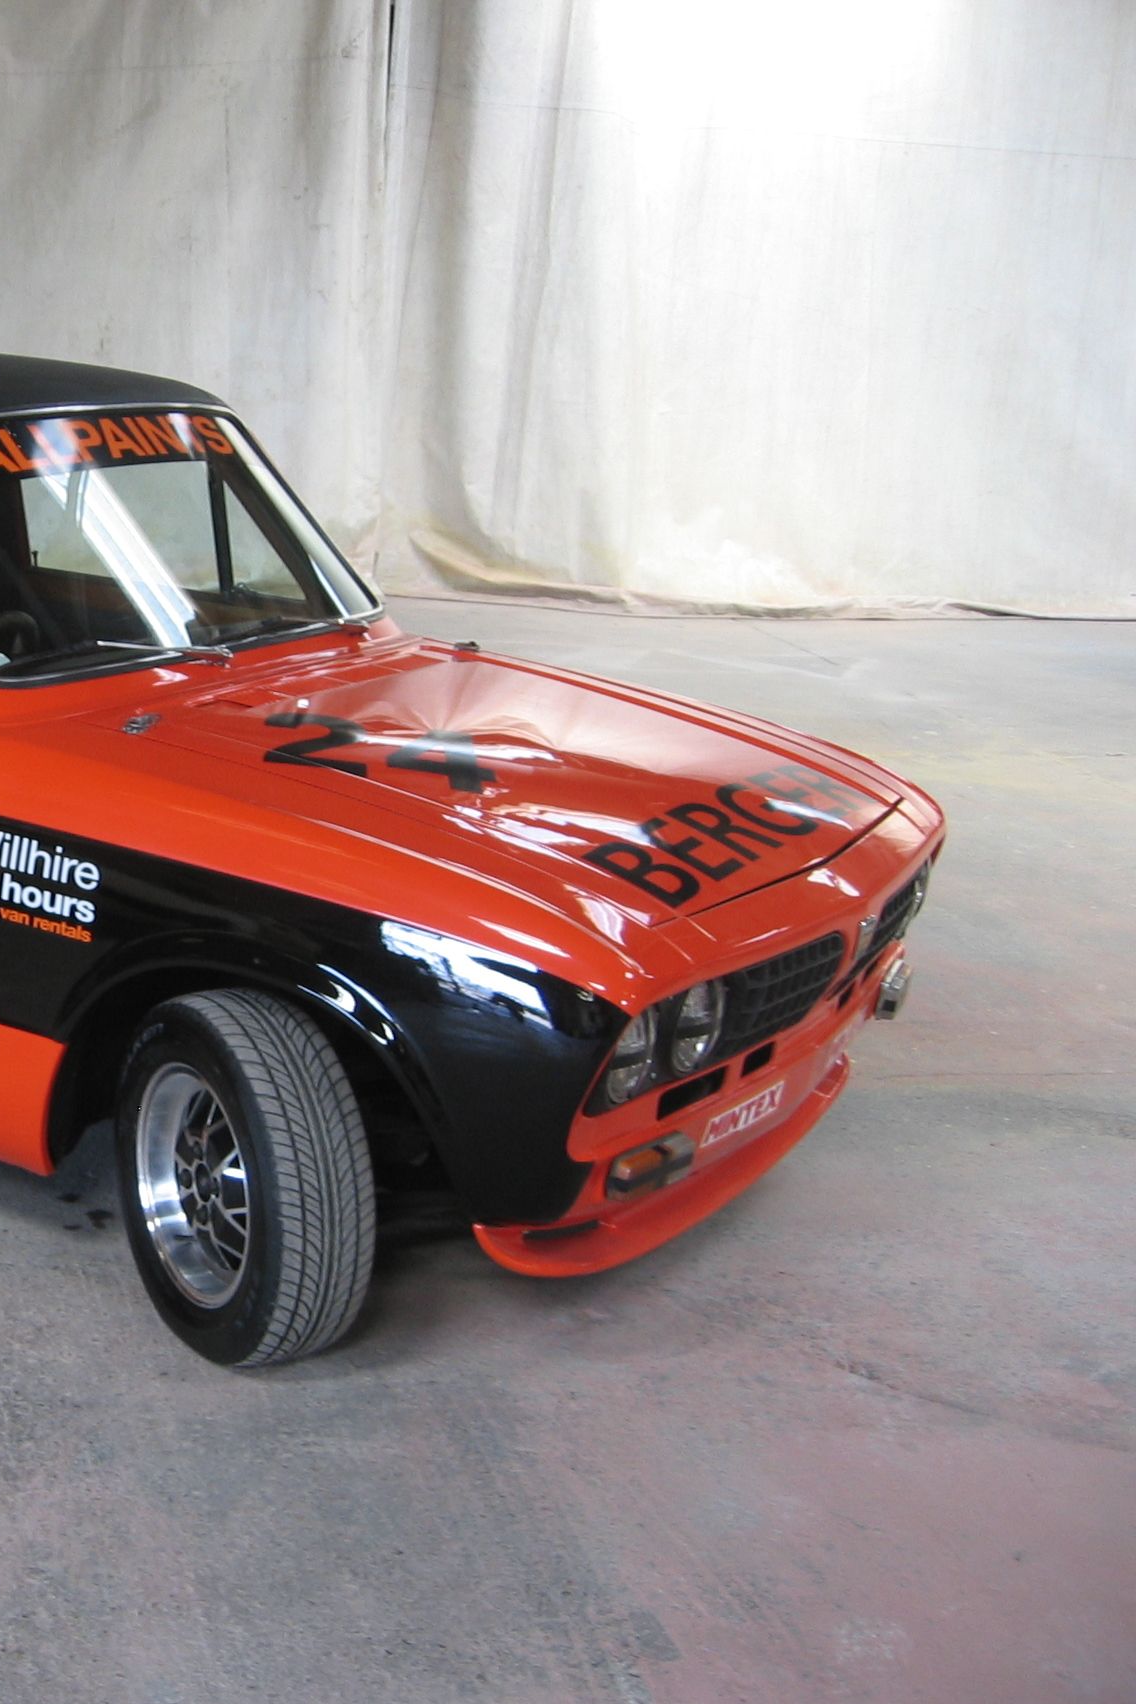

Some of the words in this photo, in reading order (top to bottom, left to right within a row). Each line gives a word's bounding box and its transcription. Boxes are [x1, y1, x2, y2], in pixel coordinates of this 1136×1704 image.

[262, 712, 498, 794] 24
[580, 764, 876, 908] BERGER
[0, 872, 97, 923] hours
[0, 907, 30, 926] van
[32, 916, 93, 943] rentals
[703, 1083, 783, 1145] MINTEX
